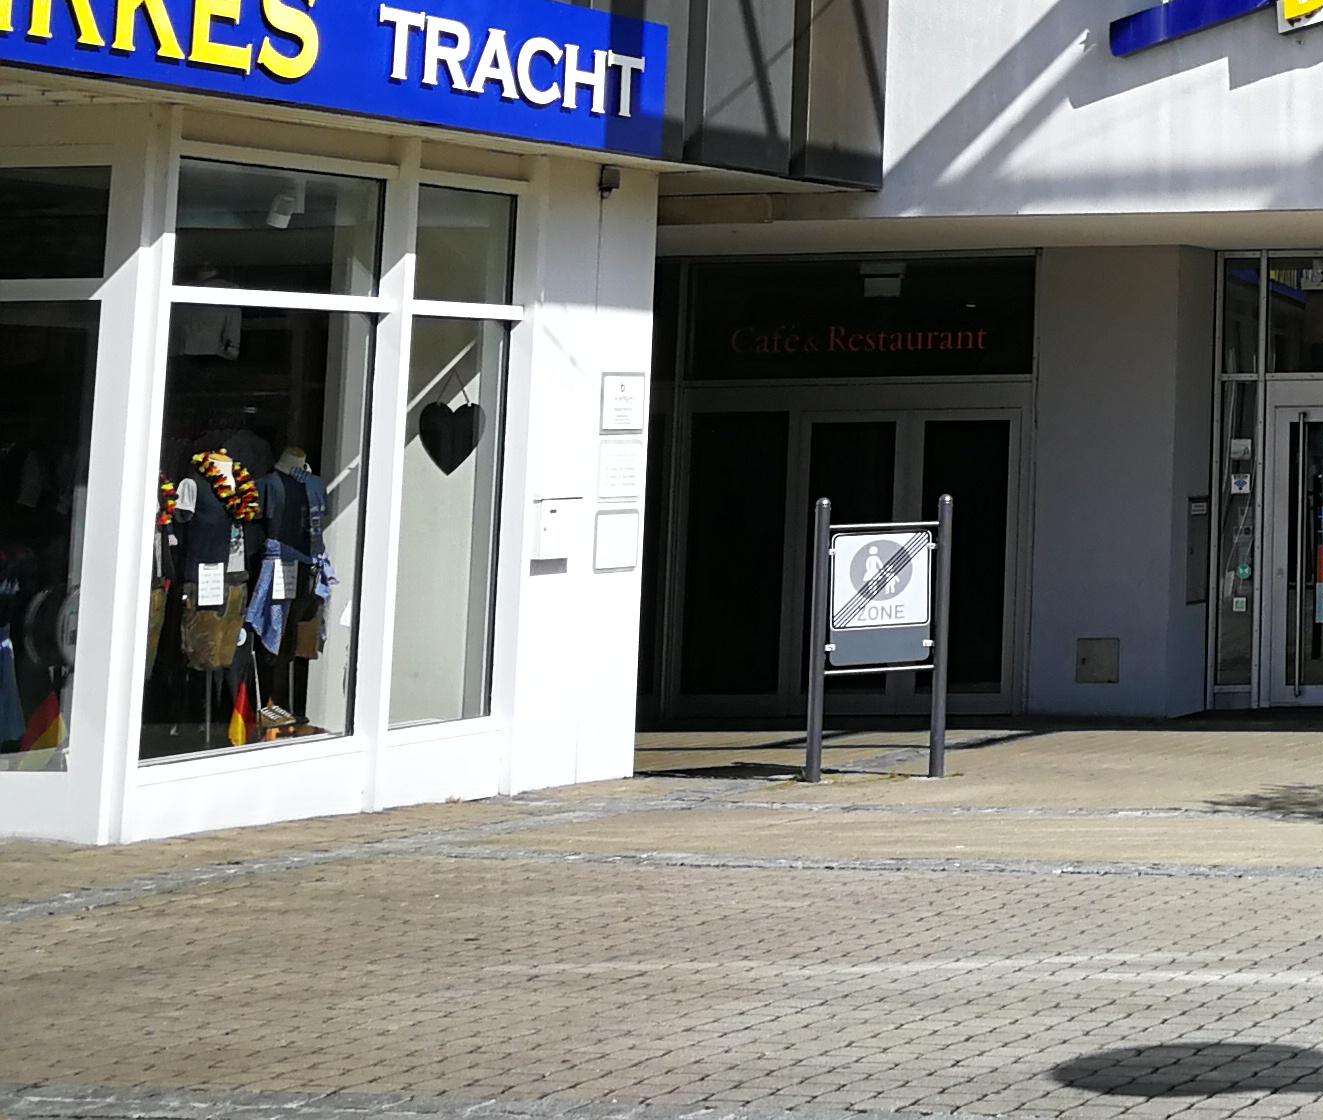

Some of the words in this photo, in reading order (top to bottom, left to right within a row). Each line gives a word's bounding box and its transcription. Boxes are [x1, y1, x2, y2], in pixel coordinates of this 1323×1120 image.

[379, 3, 646, 118] TRACHT
[826, 324, 988, 353] Restaurant
[857, 604, 905, 622] ZONE
